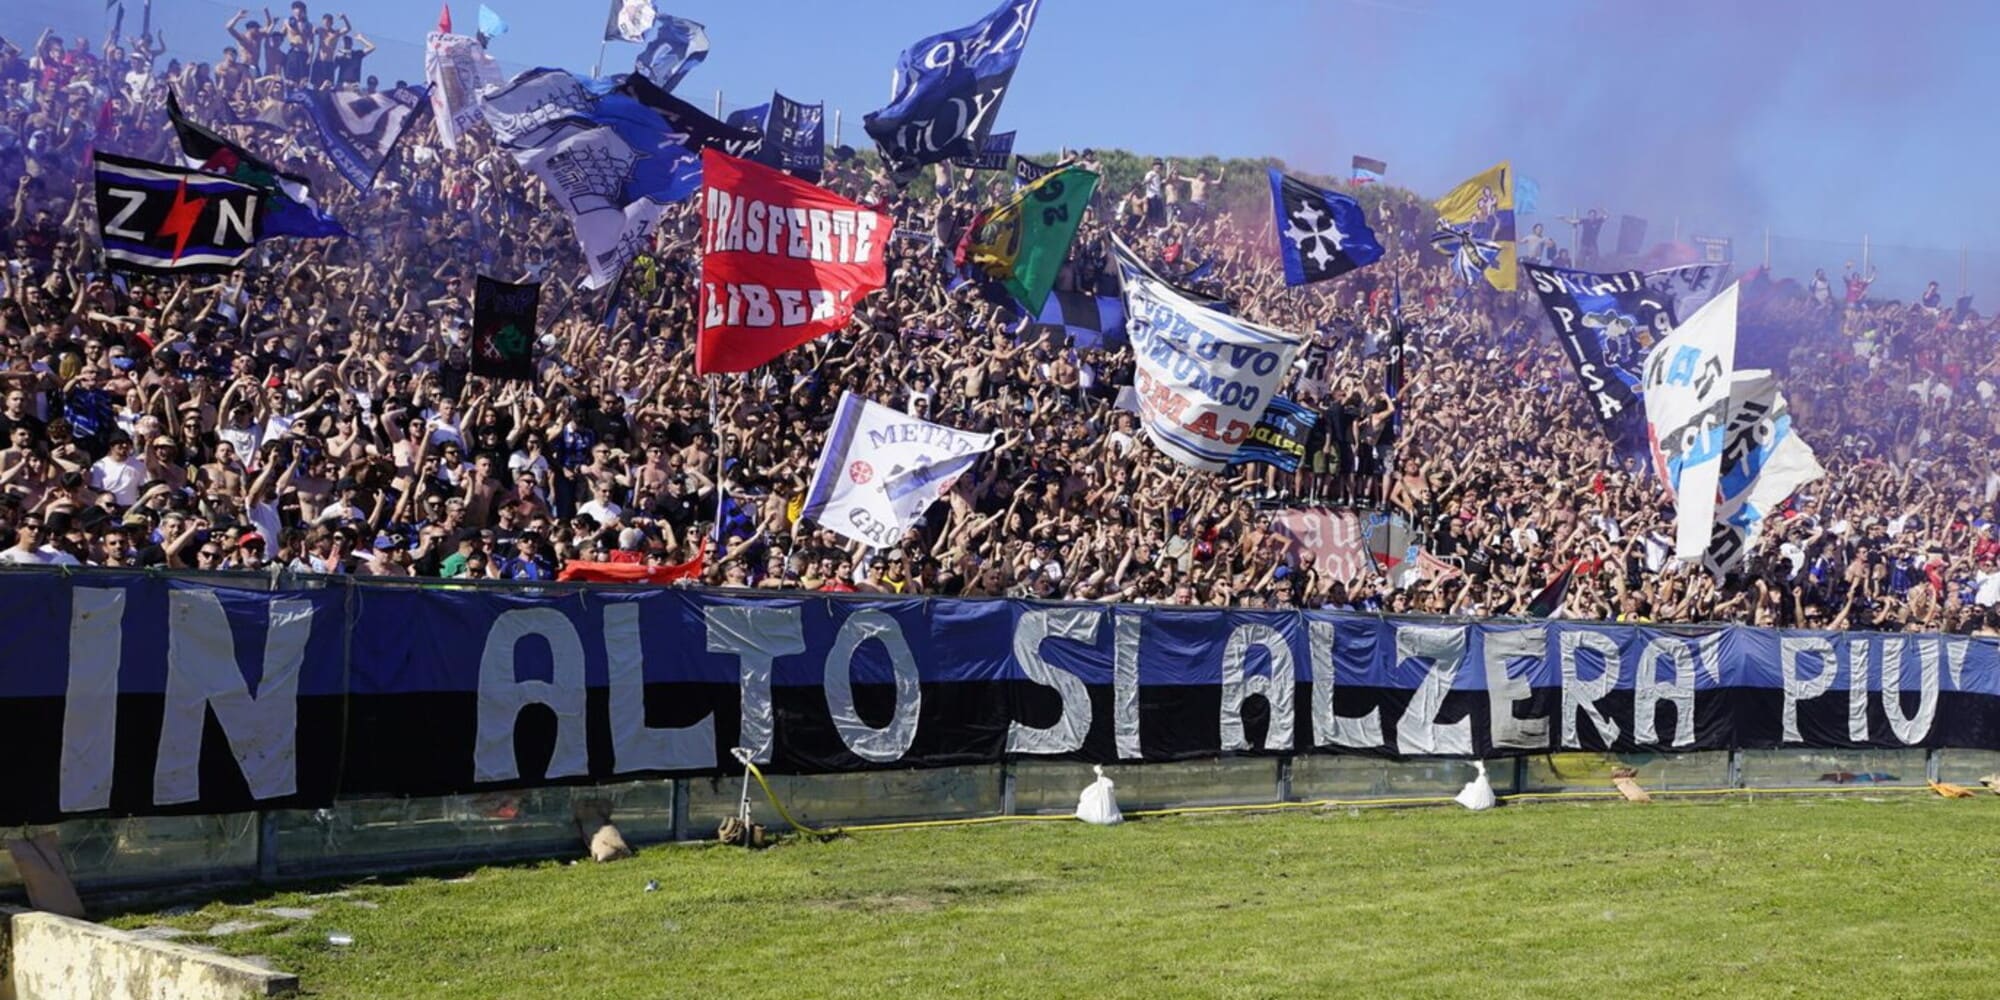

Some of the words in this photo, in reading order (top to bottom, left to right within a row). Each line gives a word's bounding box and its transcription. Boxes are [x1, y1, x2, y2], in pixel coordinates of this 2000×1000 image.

[705, 187, 877, 263] TRASFERTE
[1553, 306, 1623, 419] PISA
[60, 586, 313, 812] IN
[473, 602, 922, 783] ALTO
[1006, 607, 1143, 760] SI
